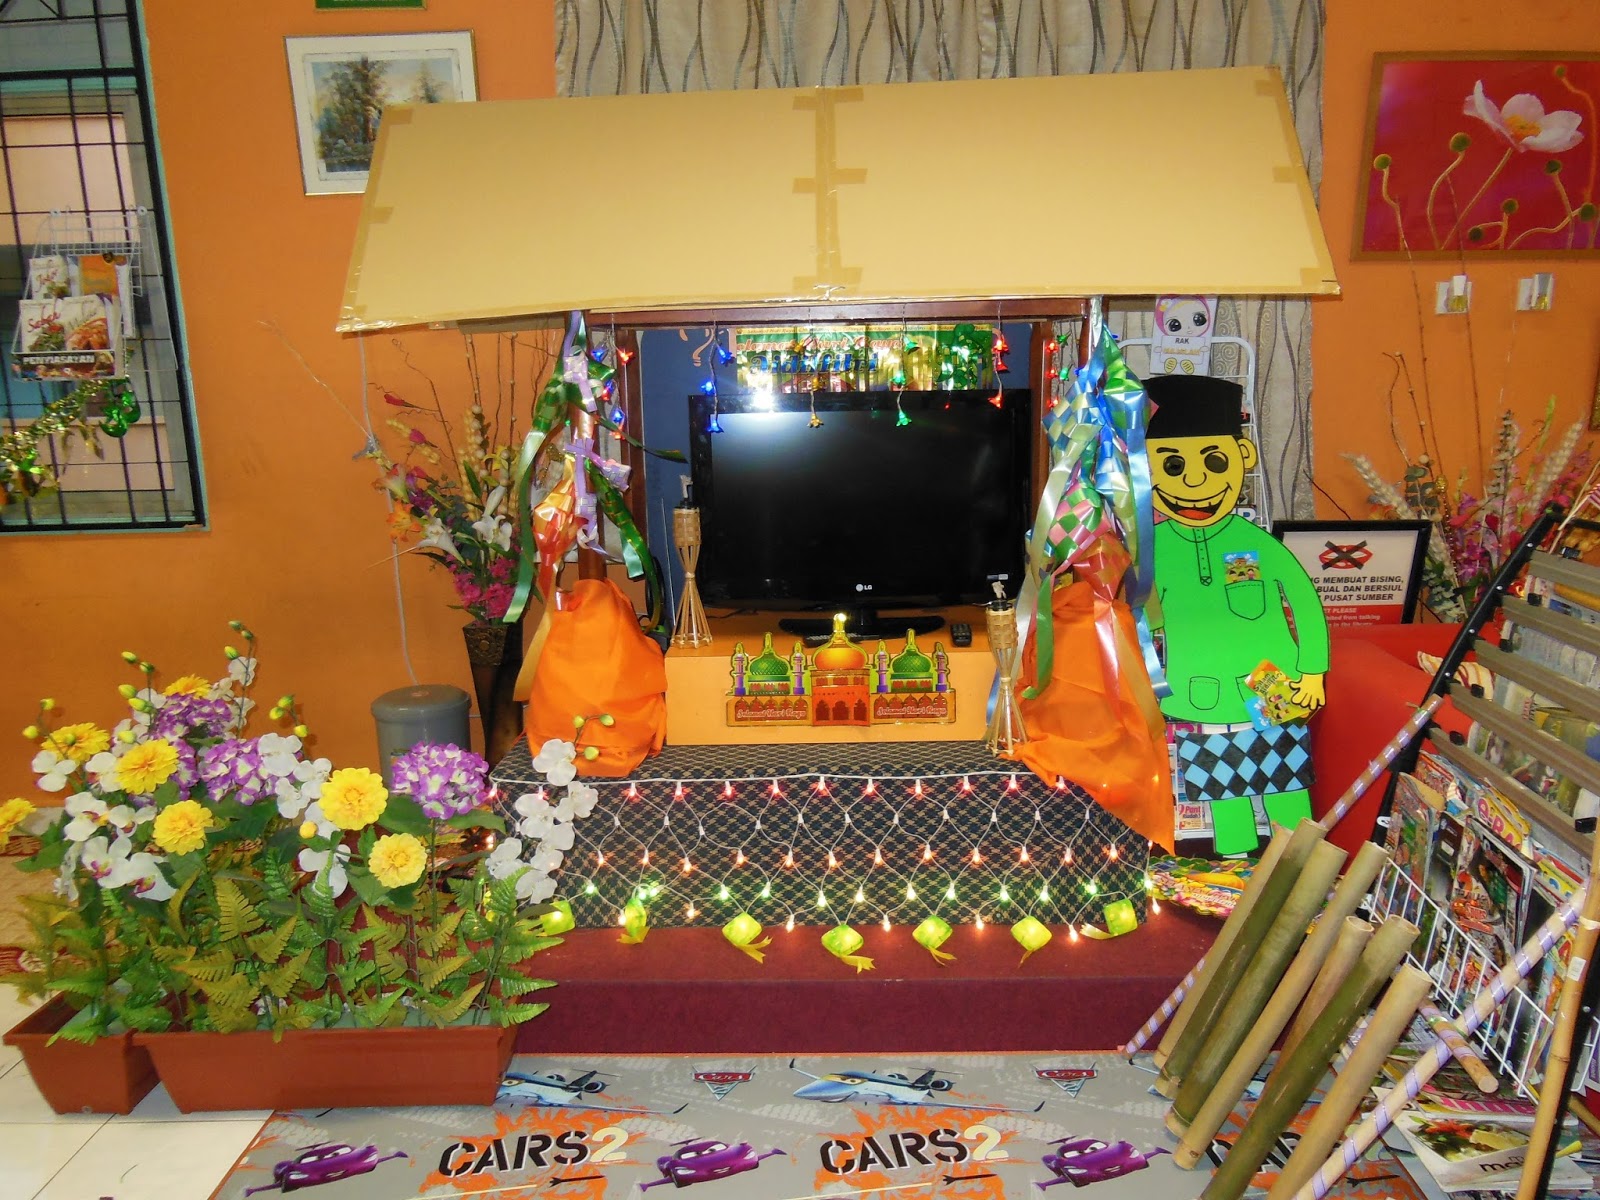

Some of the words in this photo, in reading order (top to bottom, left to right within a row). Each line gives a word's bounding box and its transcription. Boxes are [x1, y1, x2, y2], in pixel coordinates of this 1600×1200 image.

[1174, 337, 1190, 345] RAK
[1322, 576, 1368, 584] MEMBUAT
[1370, 575, 1404, 584] BISING,
[1364, 584, 1403, 592] BERSIUL
[1323, 594, 1353, 602] PUSAT
[1355, 593, 1394, 601] SUMBER
[736, 708, 767, 719] Selamat
[876, 706, 906, 716] Selamat
